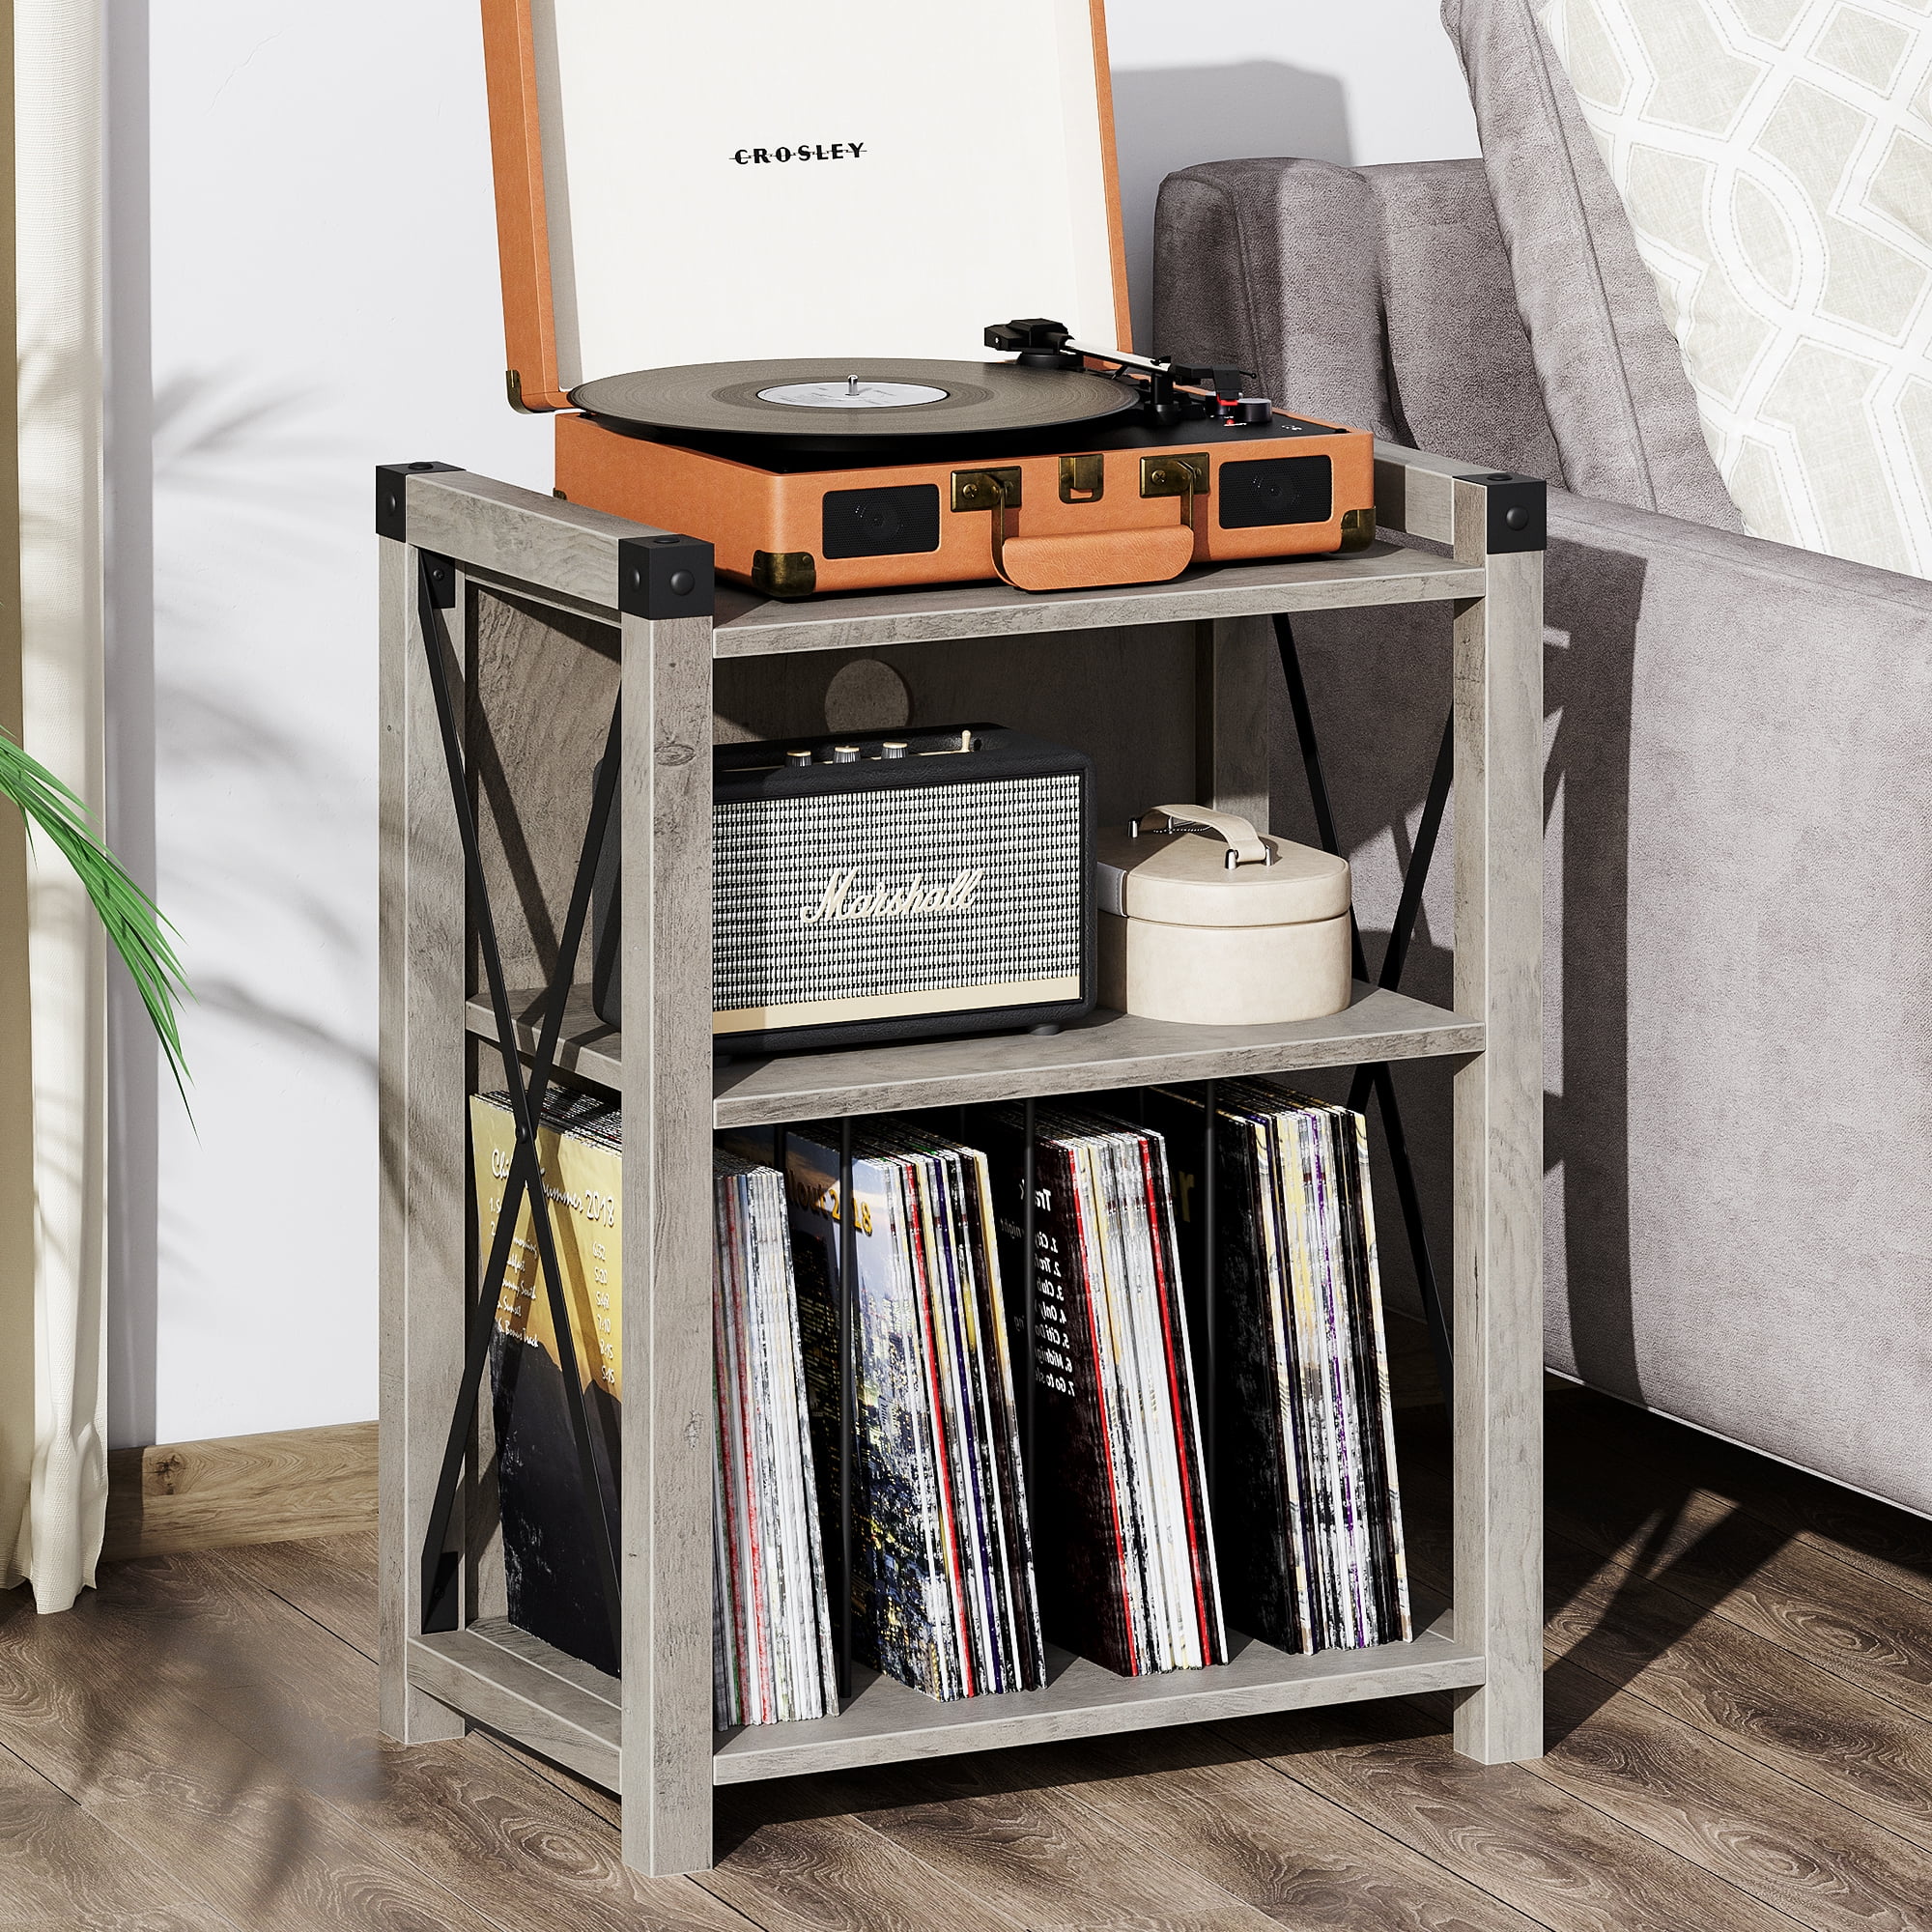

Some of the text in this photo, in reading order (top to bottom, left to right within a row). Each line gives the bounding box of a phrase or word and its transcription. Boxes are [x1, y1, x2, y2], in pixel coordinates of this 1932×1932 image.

[731, 142, 866, 165] CROSLEY
[801, 868, 985, 923] Marshall
[584, 1189, 614, 1228] 2018
[828, 1188, 873, 1236] 218
